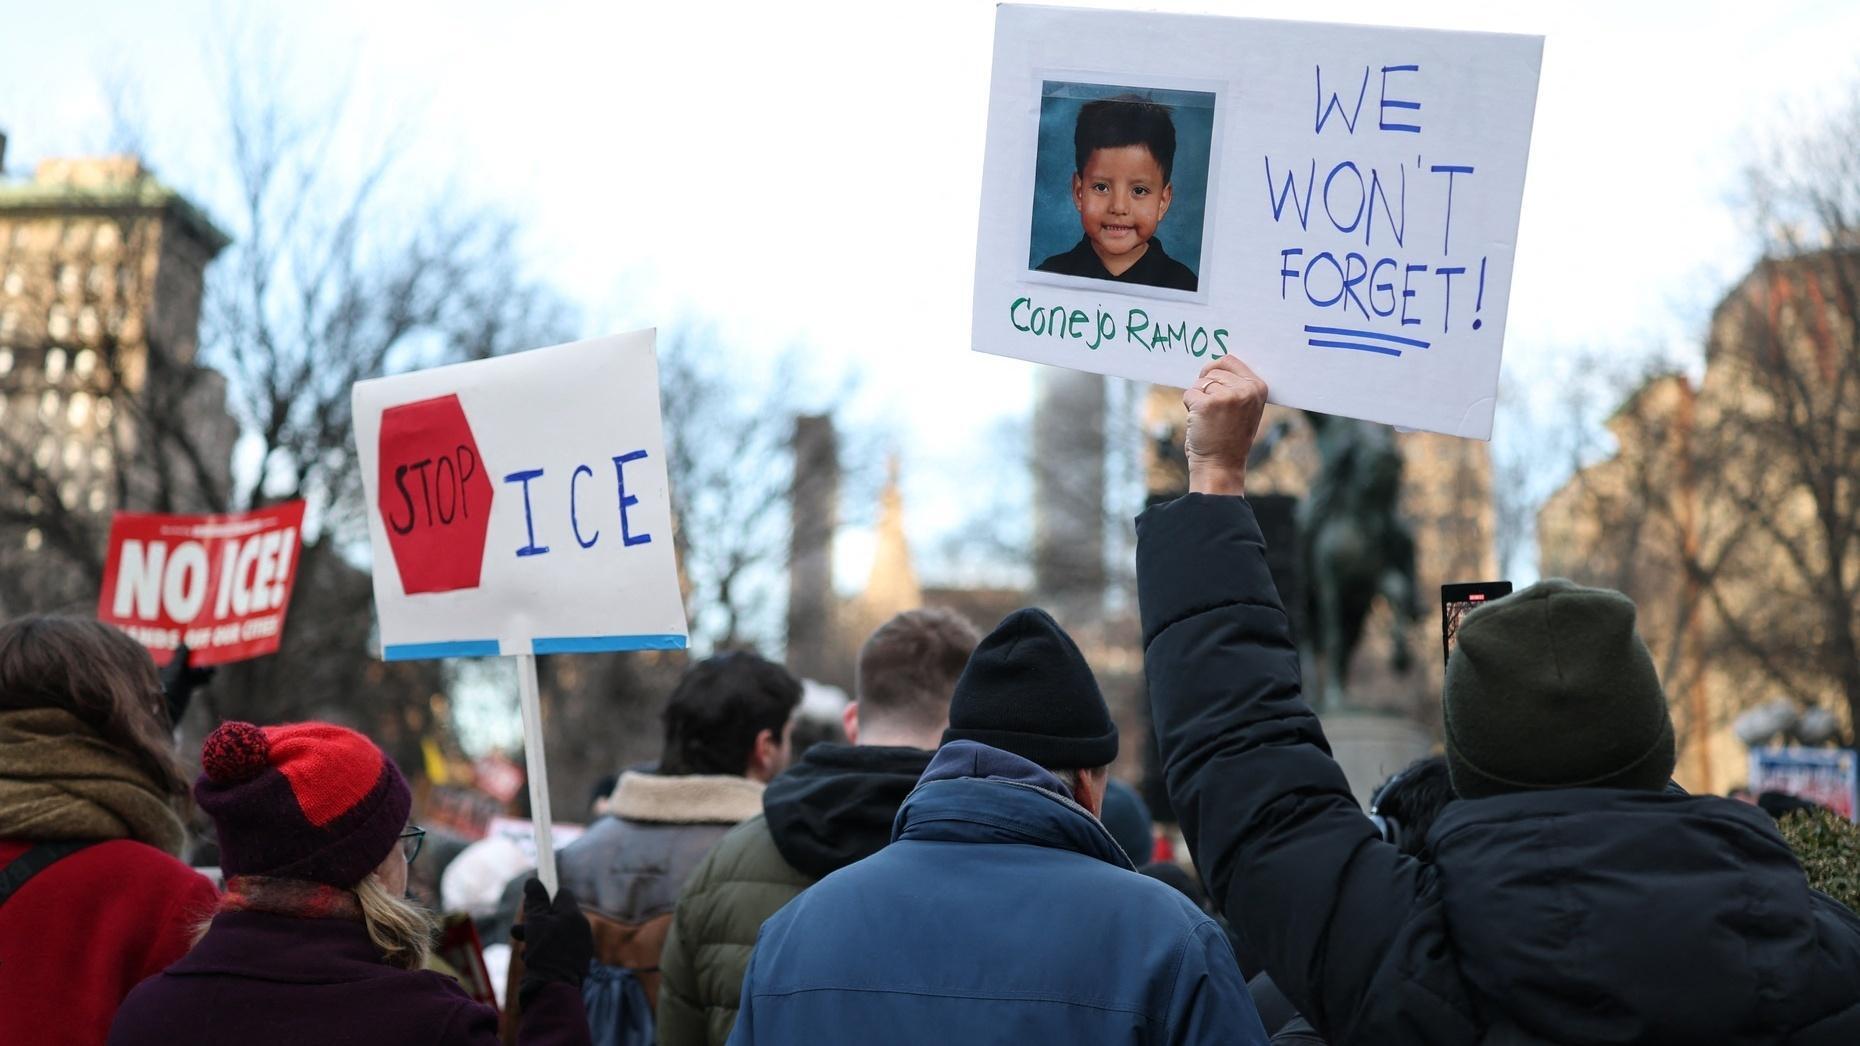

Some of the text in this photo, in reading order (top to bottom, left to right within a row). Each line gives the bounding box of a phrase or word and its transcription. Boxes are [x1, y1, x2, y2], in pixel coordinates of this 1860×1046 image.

[1314, 63, 1422, 135] WE
[1264, 154, 1475, 256] WON'T
[1009, 296, 1229, 360] Conejo RAMOS
[1280, 248, 1487, 334] FORGET!
[389, 444, 652, 557] STOP ICE
[113, 527, 296, 624] NO ICE!
[117, 625, 179, 650] ANDS
